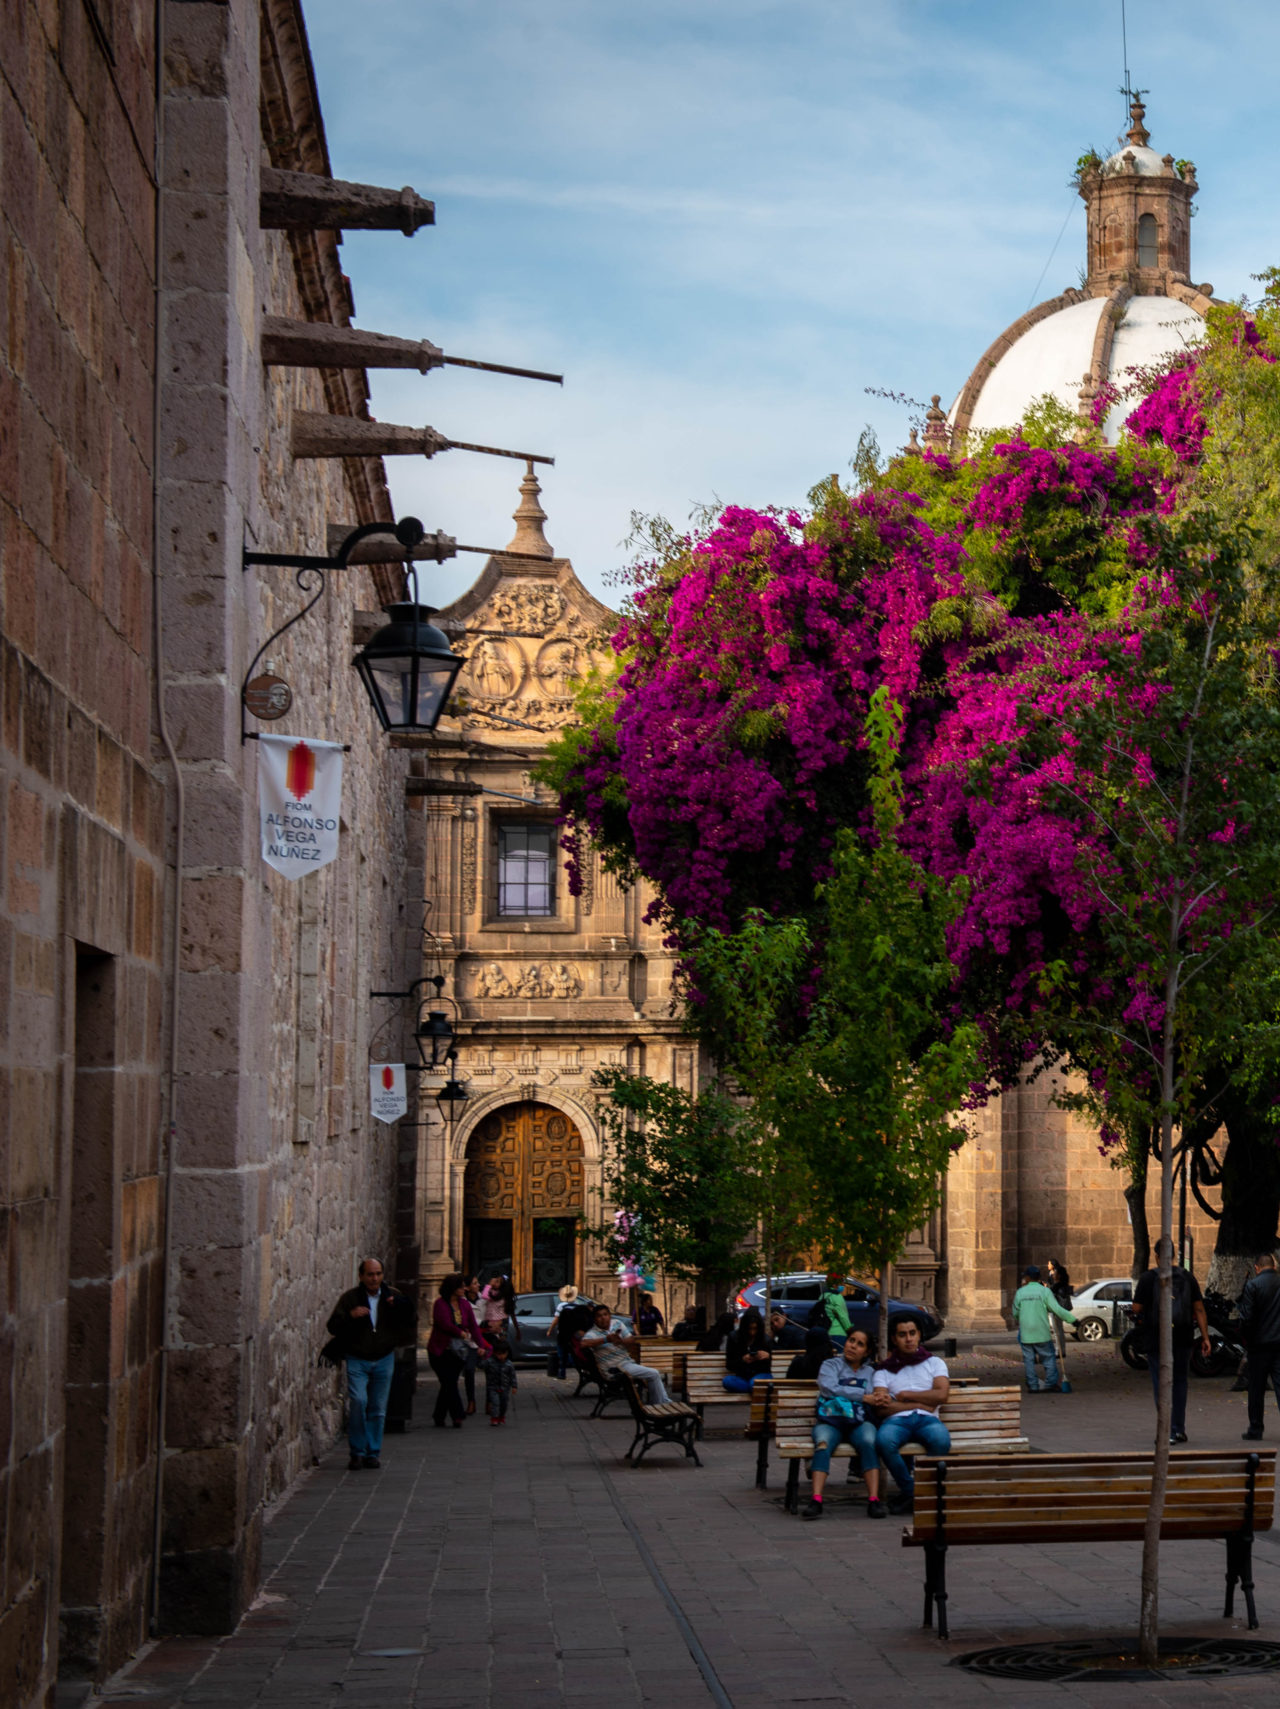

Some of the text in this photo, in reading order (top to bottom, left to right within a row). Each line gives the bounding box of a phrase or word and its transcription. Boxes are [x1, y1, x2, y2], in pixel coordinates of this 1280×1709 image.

[285, 801, 312, 811] FIOM
[265, 813, 337, 831] ALFONSO
[275, 828, 317, 844] VEGA
[268, 844, 321, 861] NÚÑEZ
